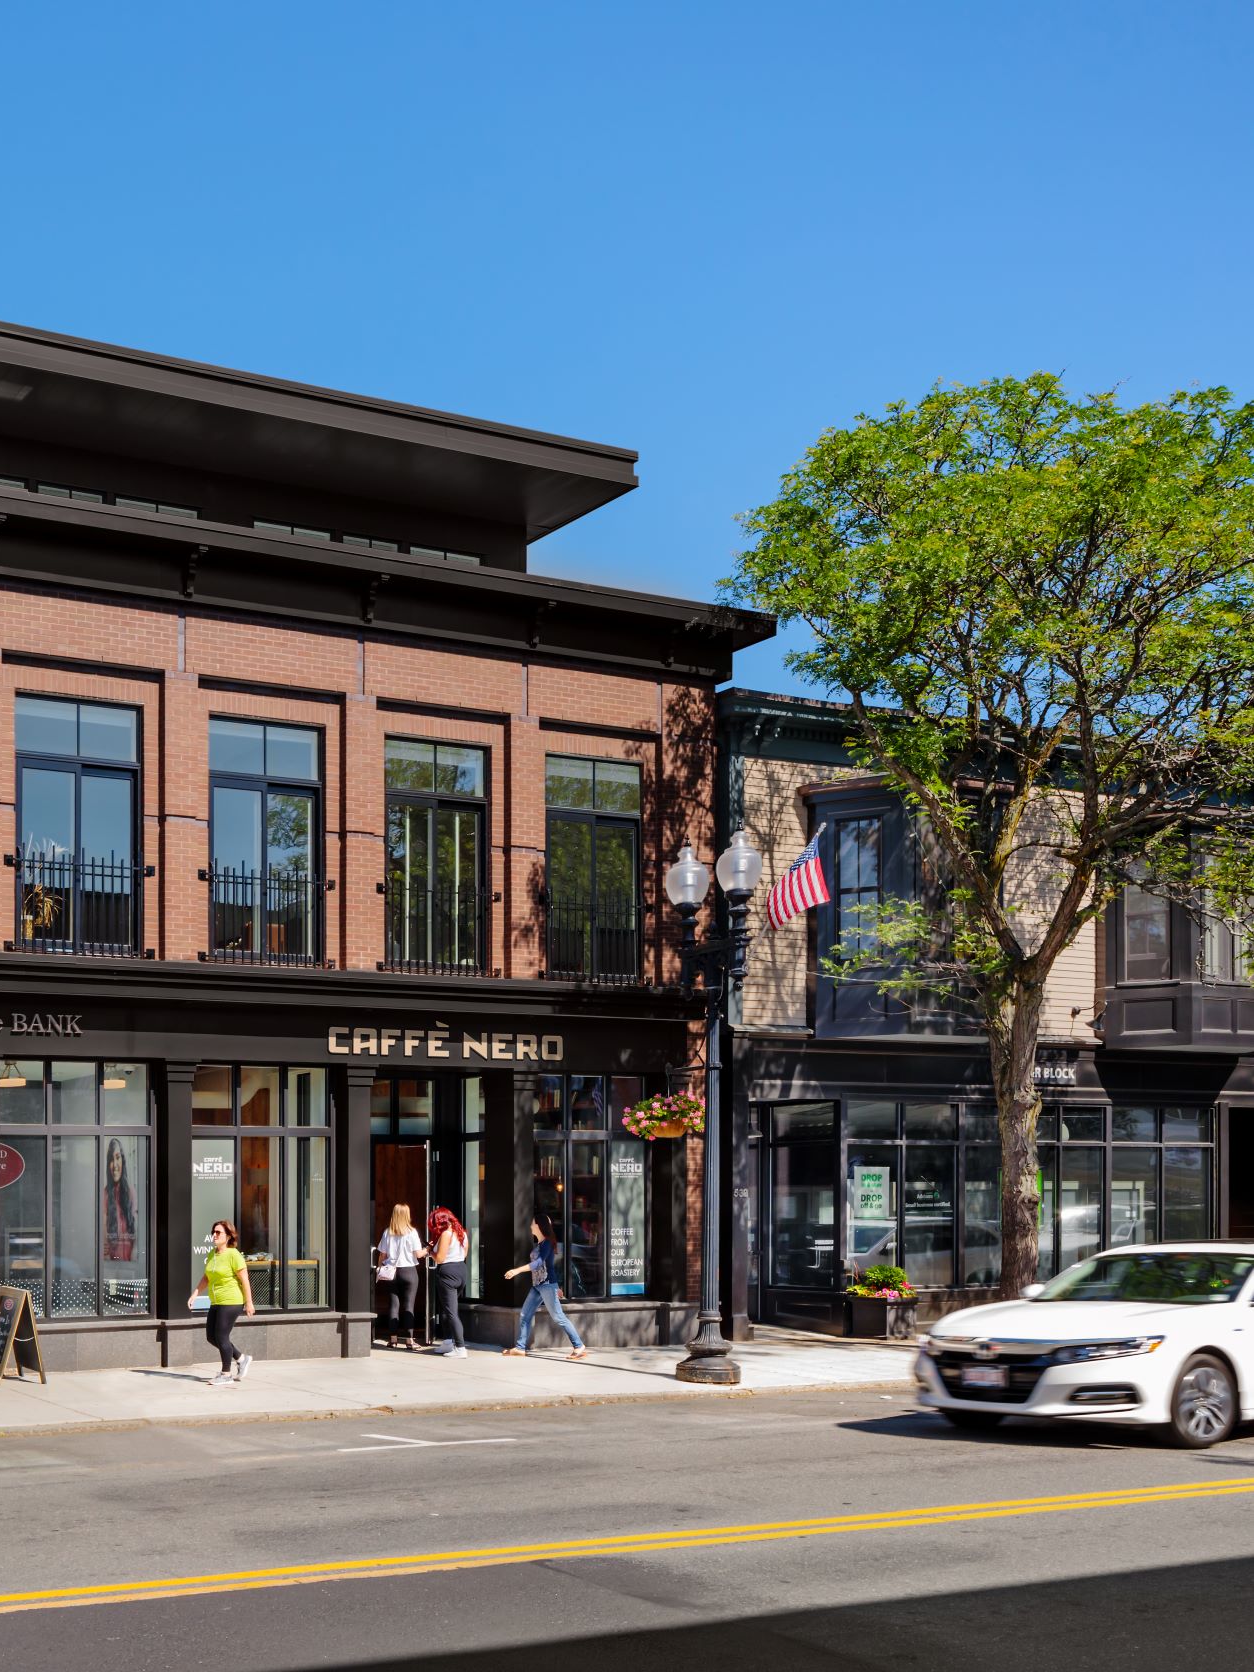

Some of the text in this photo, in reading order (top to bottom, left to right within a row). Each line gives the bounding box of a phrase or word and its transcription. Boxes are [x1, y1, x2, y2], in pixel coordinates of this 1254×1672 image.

[10, 1012, 84, 1034] BANK
[328, 1020, 564, 1061] CAFFÈ NERO
[1043, 1067, 1075, 1079] BLOCK
[192, 1162, 233, 1173] NERO
[610, 1163, 643, 1173] NERO
[860, 1194, 883, 1202] DROP
[611, 1228, 634, 1236] COFFEE
[611, 1238, 629, 1246] FROM
[611, 1248, 625, 1256] OUR
[611, 1258, 643, 1267] EUROPEAN
[611, 1268, 641, 1277] ROASTERY
